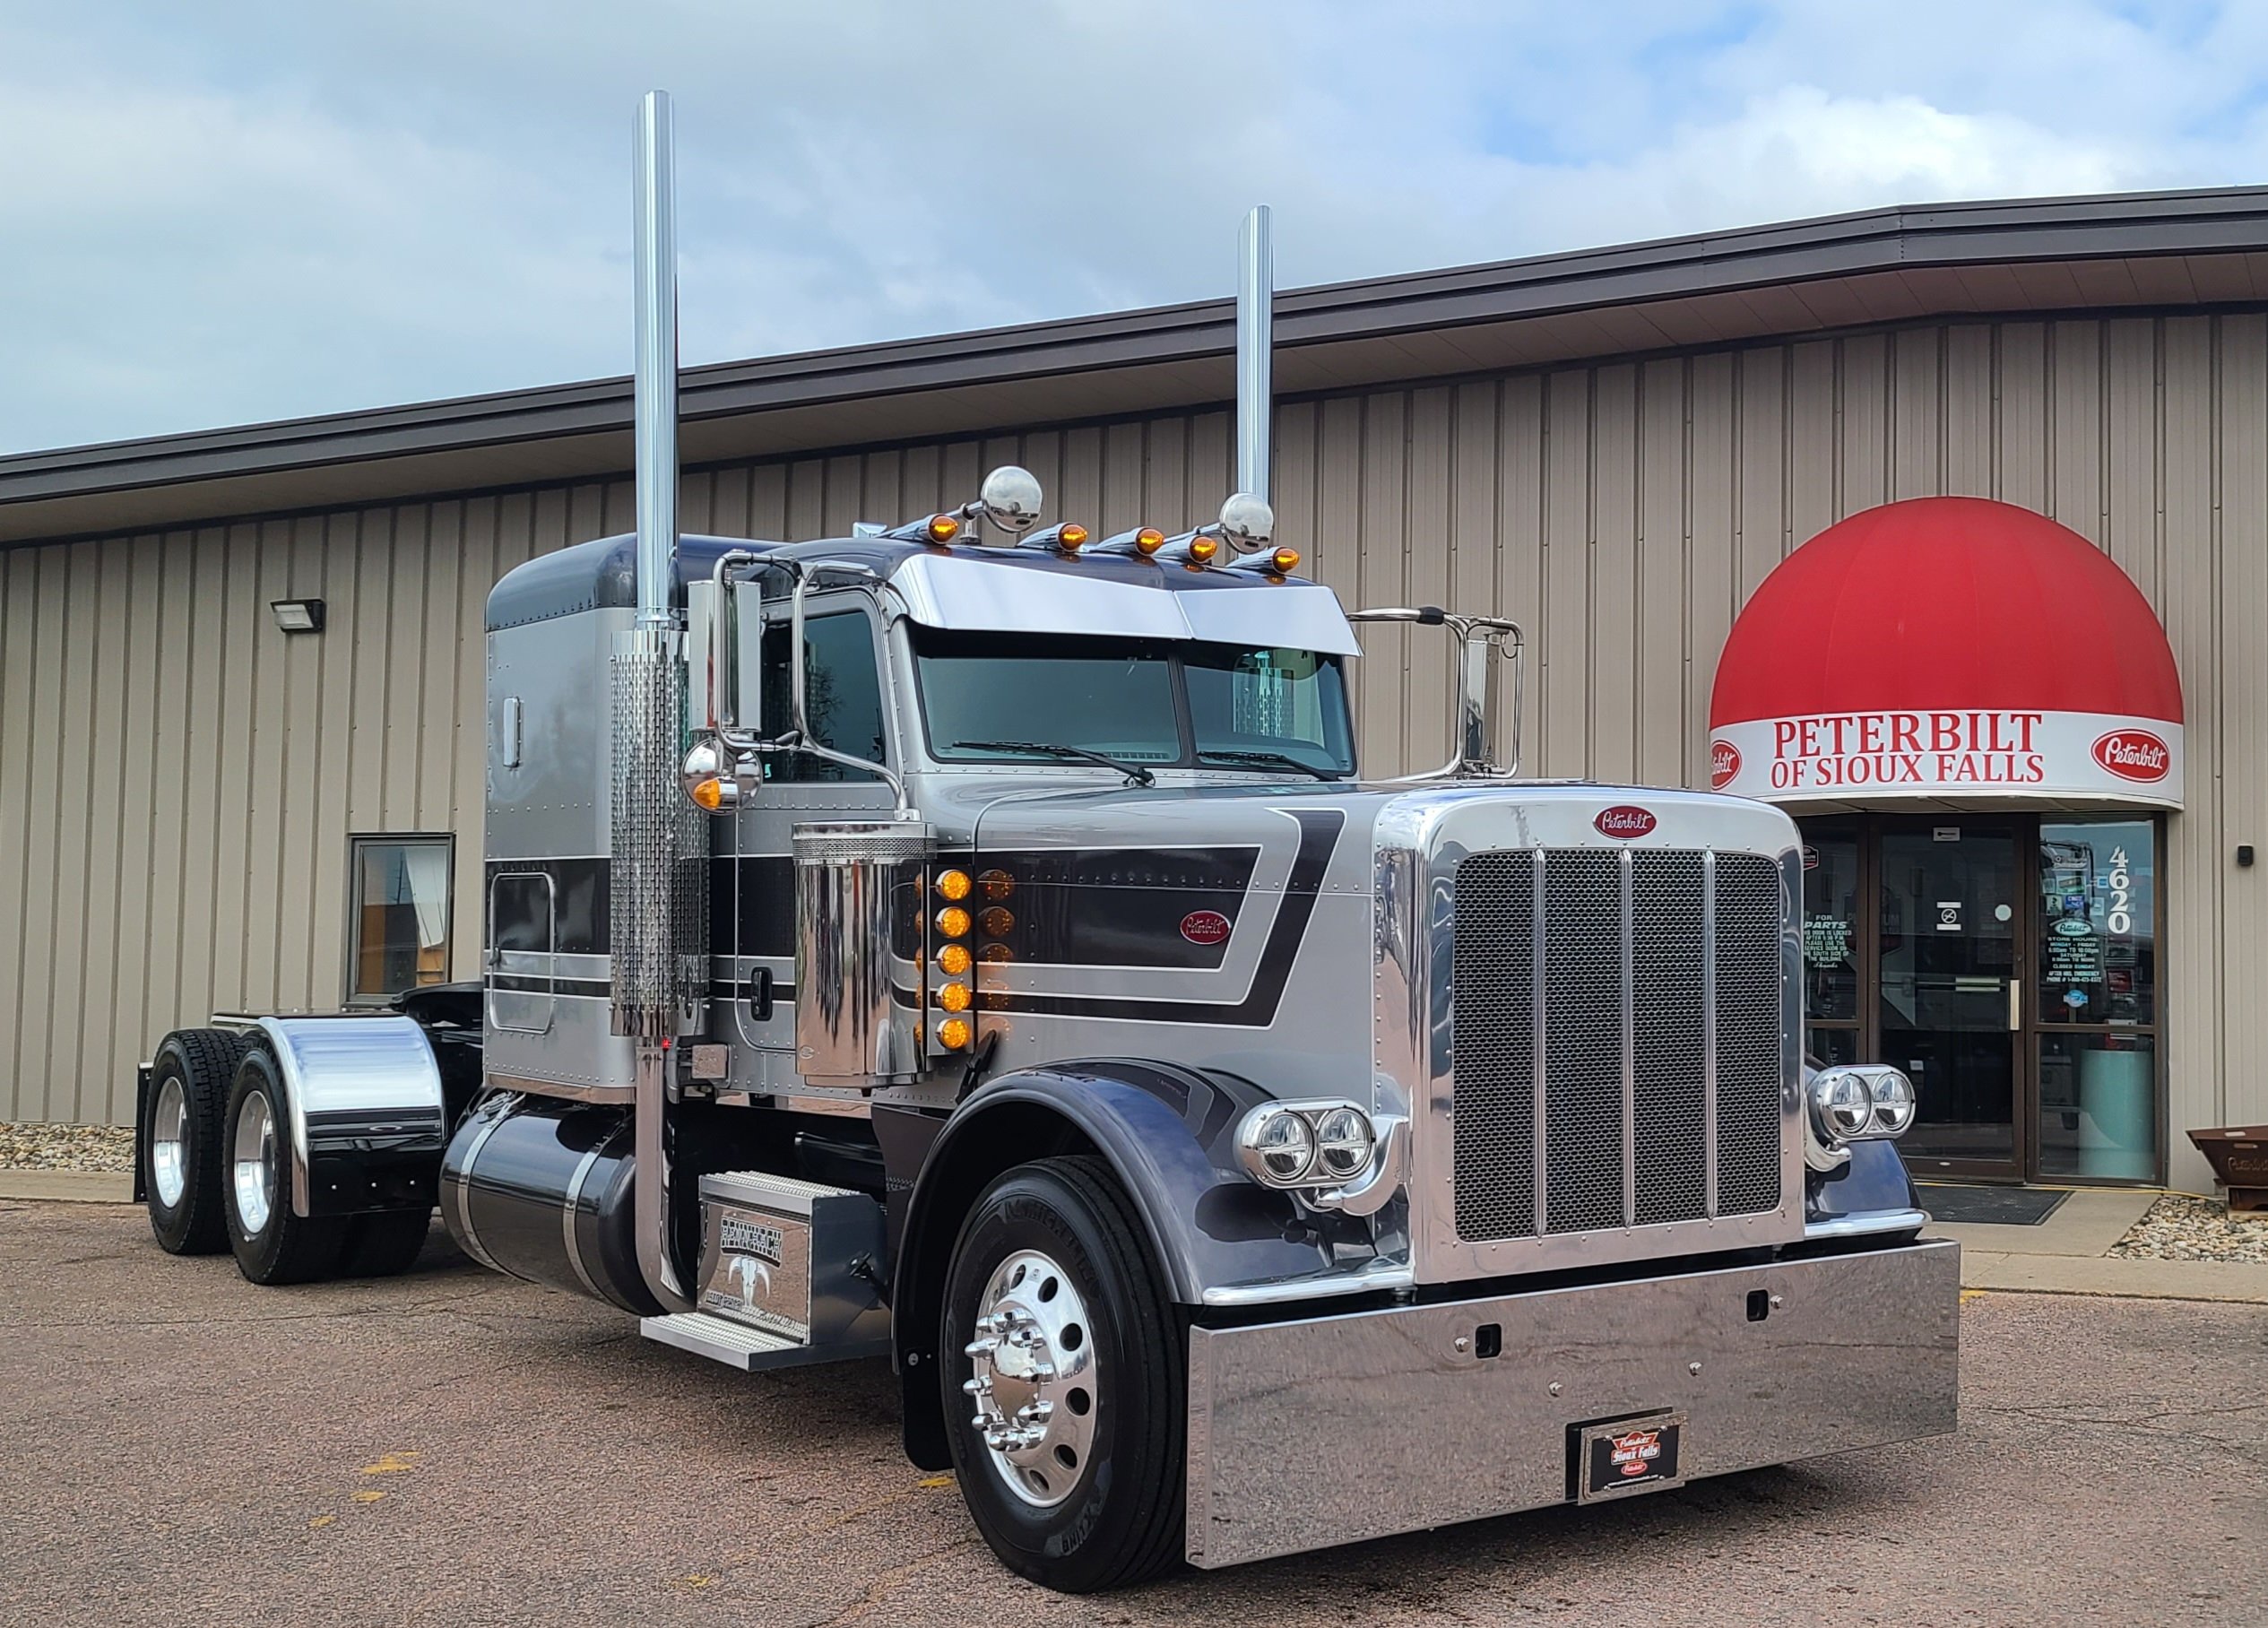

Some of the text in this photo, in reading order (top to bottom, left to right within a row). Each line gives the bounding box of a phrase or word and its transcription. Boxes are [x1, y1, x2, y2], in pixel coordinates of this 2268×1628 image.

[1773, 714, 2043, 759] PETERBILT
[2105, 737, 2166, 770] Peterbilt
[1770, 753, 2044, 788] OF SIOUX FALLS
[1602, 810, 1651, 830] Peterbilt
[2108, 845, 2131, 933] 4620
[1186, 916, 1225, 935] Peterbilt
[1804, 921, 1848, 930] PARTS
[2228, 1156, 2268, 1173] Peterbil
[1612, 1444, 1658, 1463] Sioux Falls
